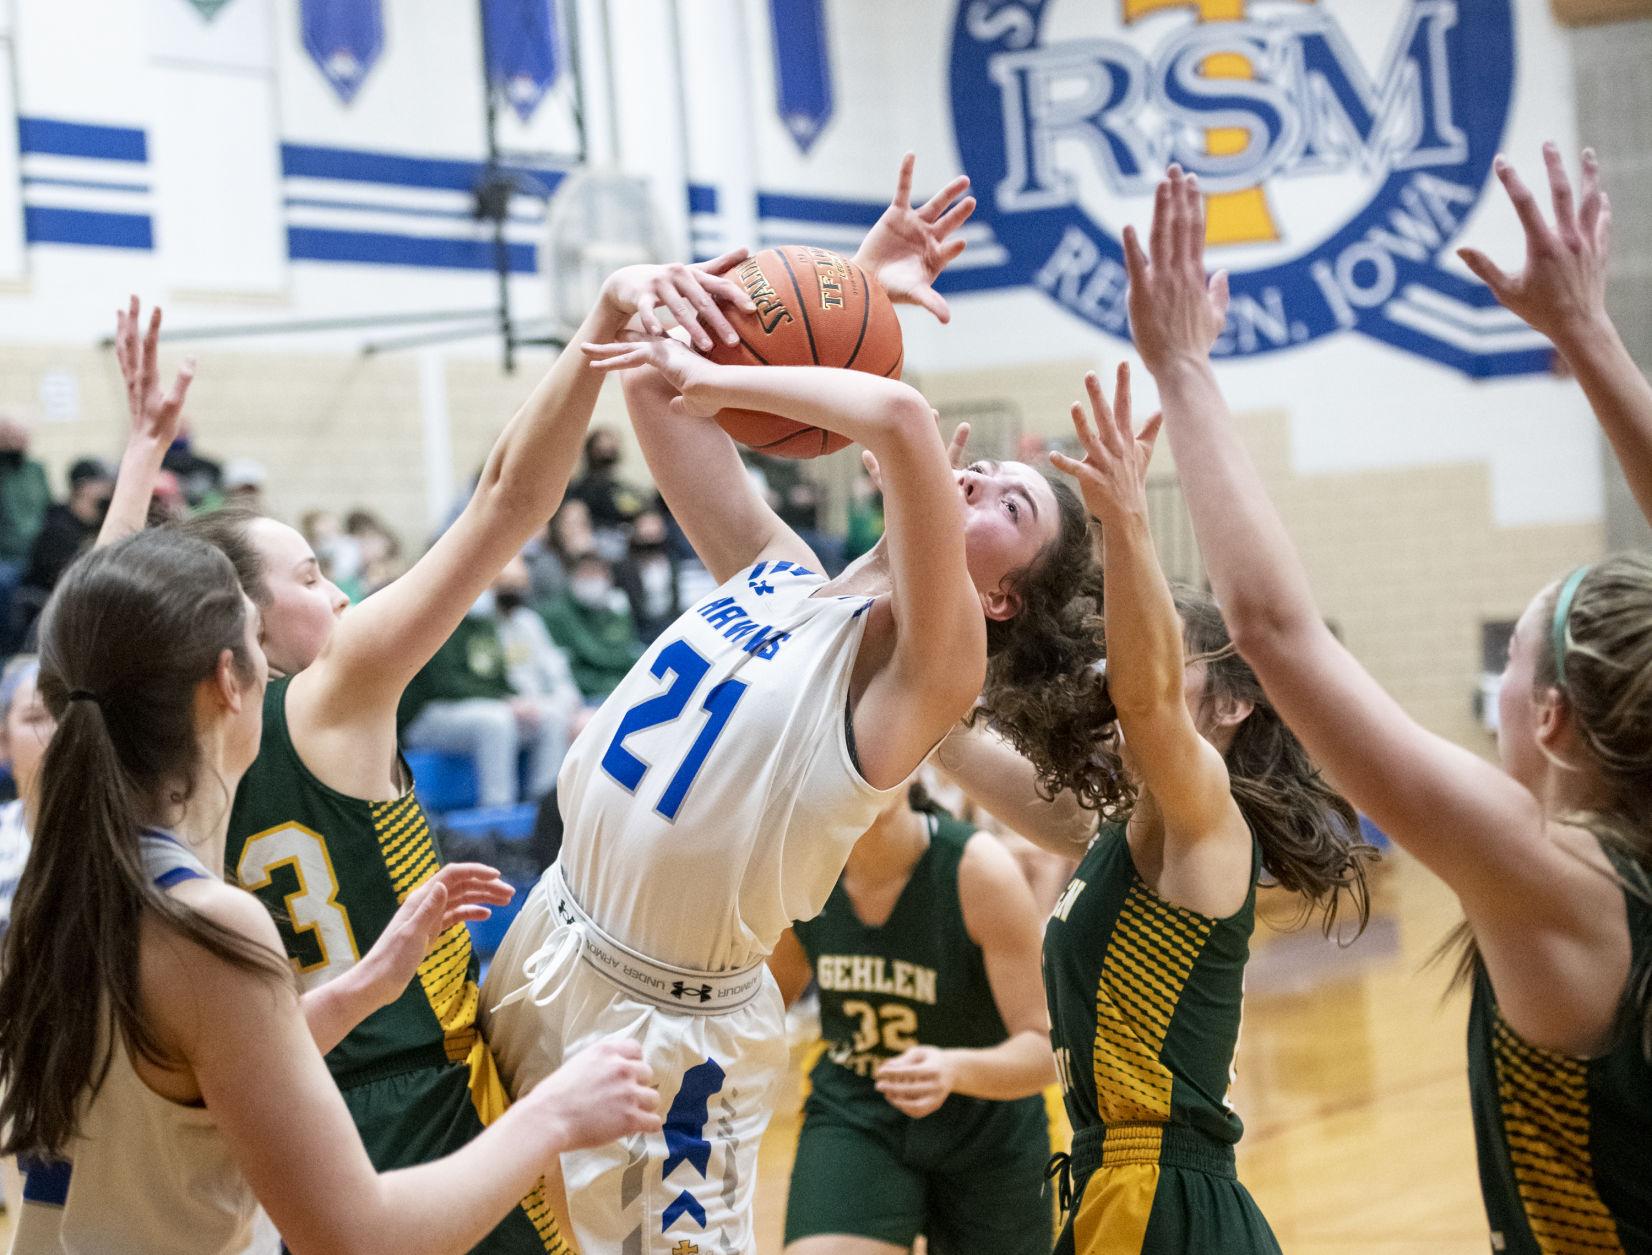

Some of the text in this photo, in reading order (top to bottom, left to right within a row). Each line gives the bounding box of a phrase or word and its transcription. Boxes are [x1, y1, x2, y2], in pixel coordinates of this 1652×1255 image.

[988, 0, 1469, 212] RSM
[1311, 171, 1477, 328] IOWA
[697, 596, 791, 661] HAWKS
[600, 635, 752, 826] 21
[236, 819, 362, 998] 3
[623, 966, 666, 990] UNDER
[717, 976, 759, 998] ARMOUR
[816, 954, 938, 1007] GEHLEN
[841, 1000, 919, 1051] 32
